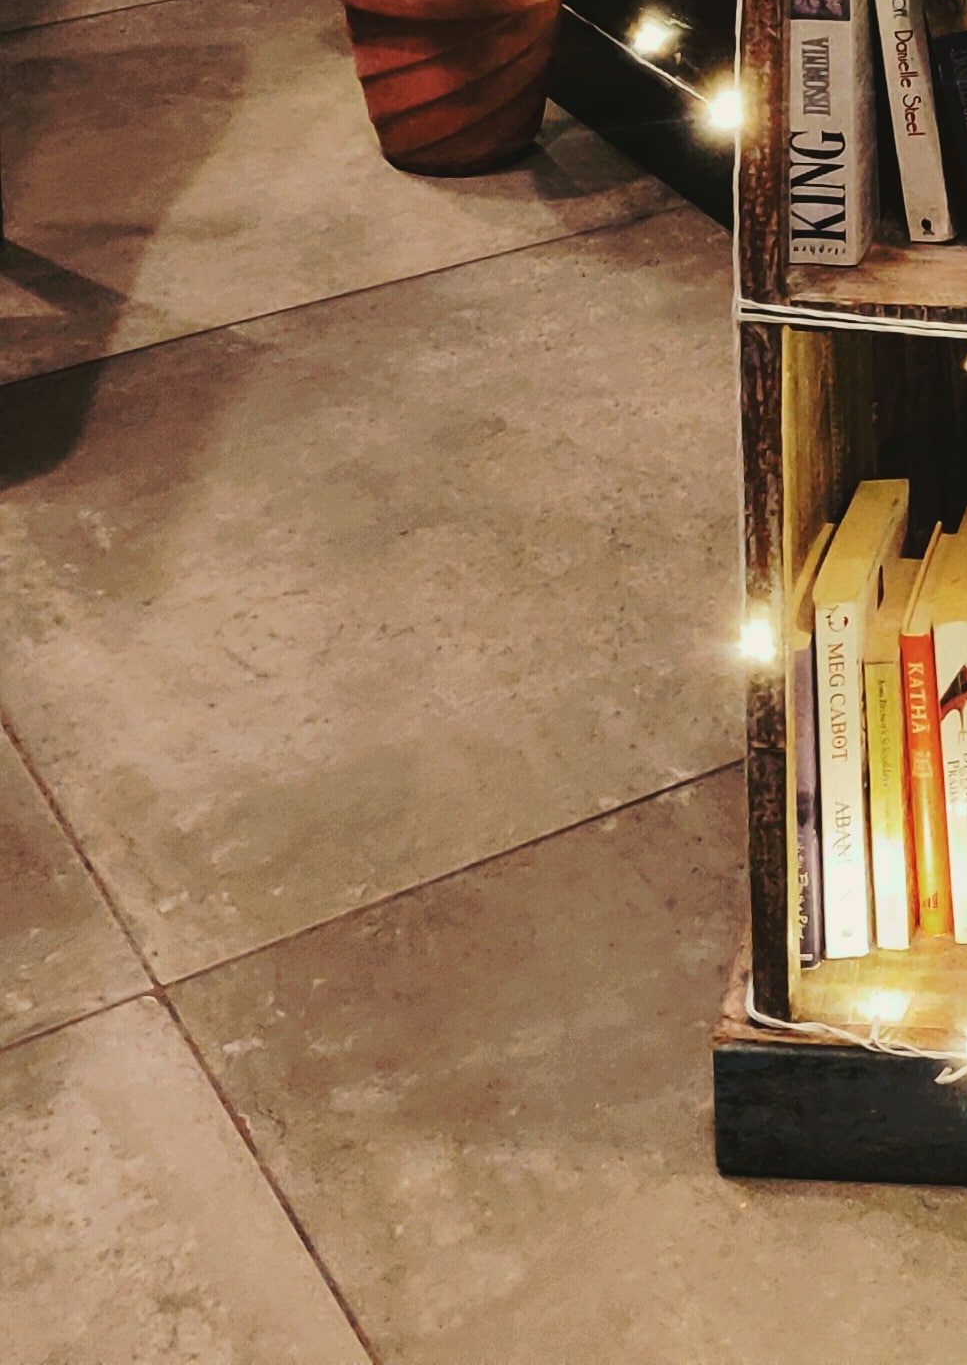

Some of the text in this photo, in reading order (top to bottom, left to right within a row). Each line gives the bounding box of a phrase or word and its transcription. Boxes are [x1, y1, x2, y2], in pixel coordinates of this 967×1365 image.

[802, 37, 830, 117] INSOMNIA
[894, 30, 919, 88] Danielle
[902, 93, 927, 137] Steel
[789, 131, 846, 243] KING
[828, 642, 849, 763] MEG CABOT
